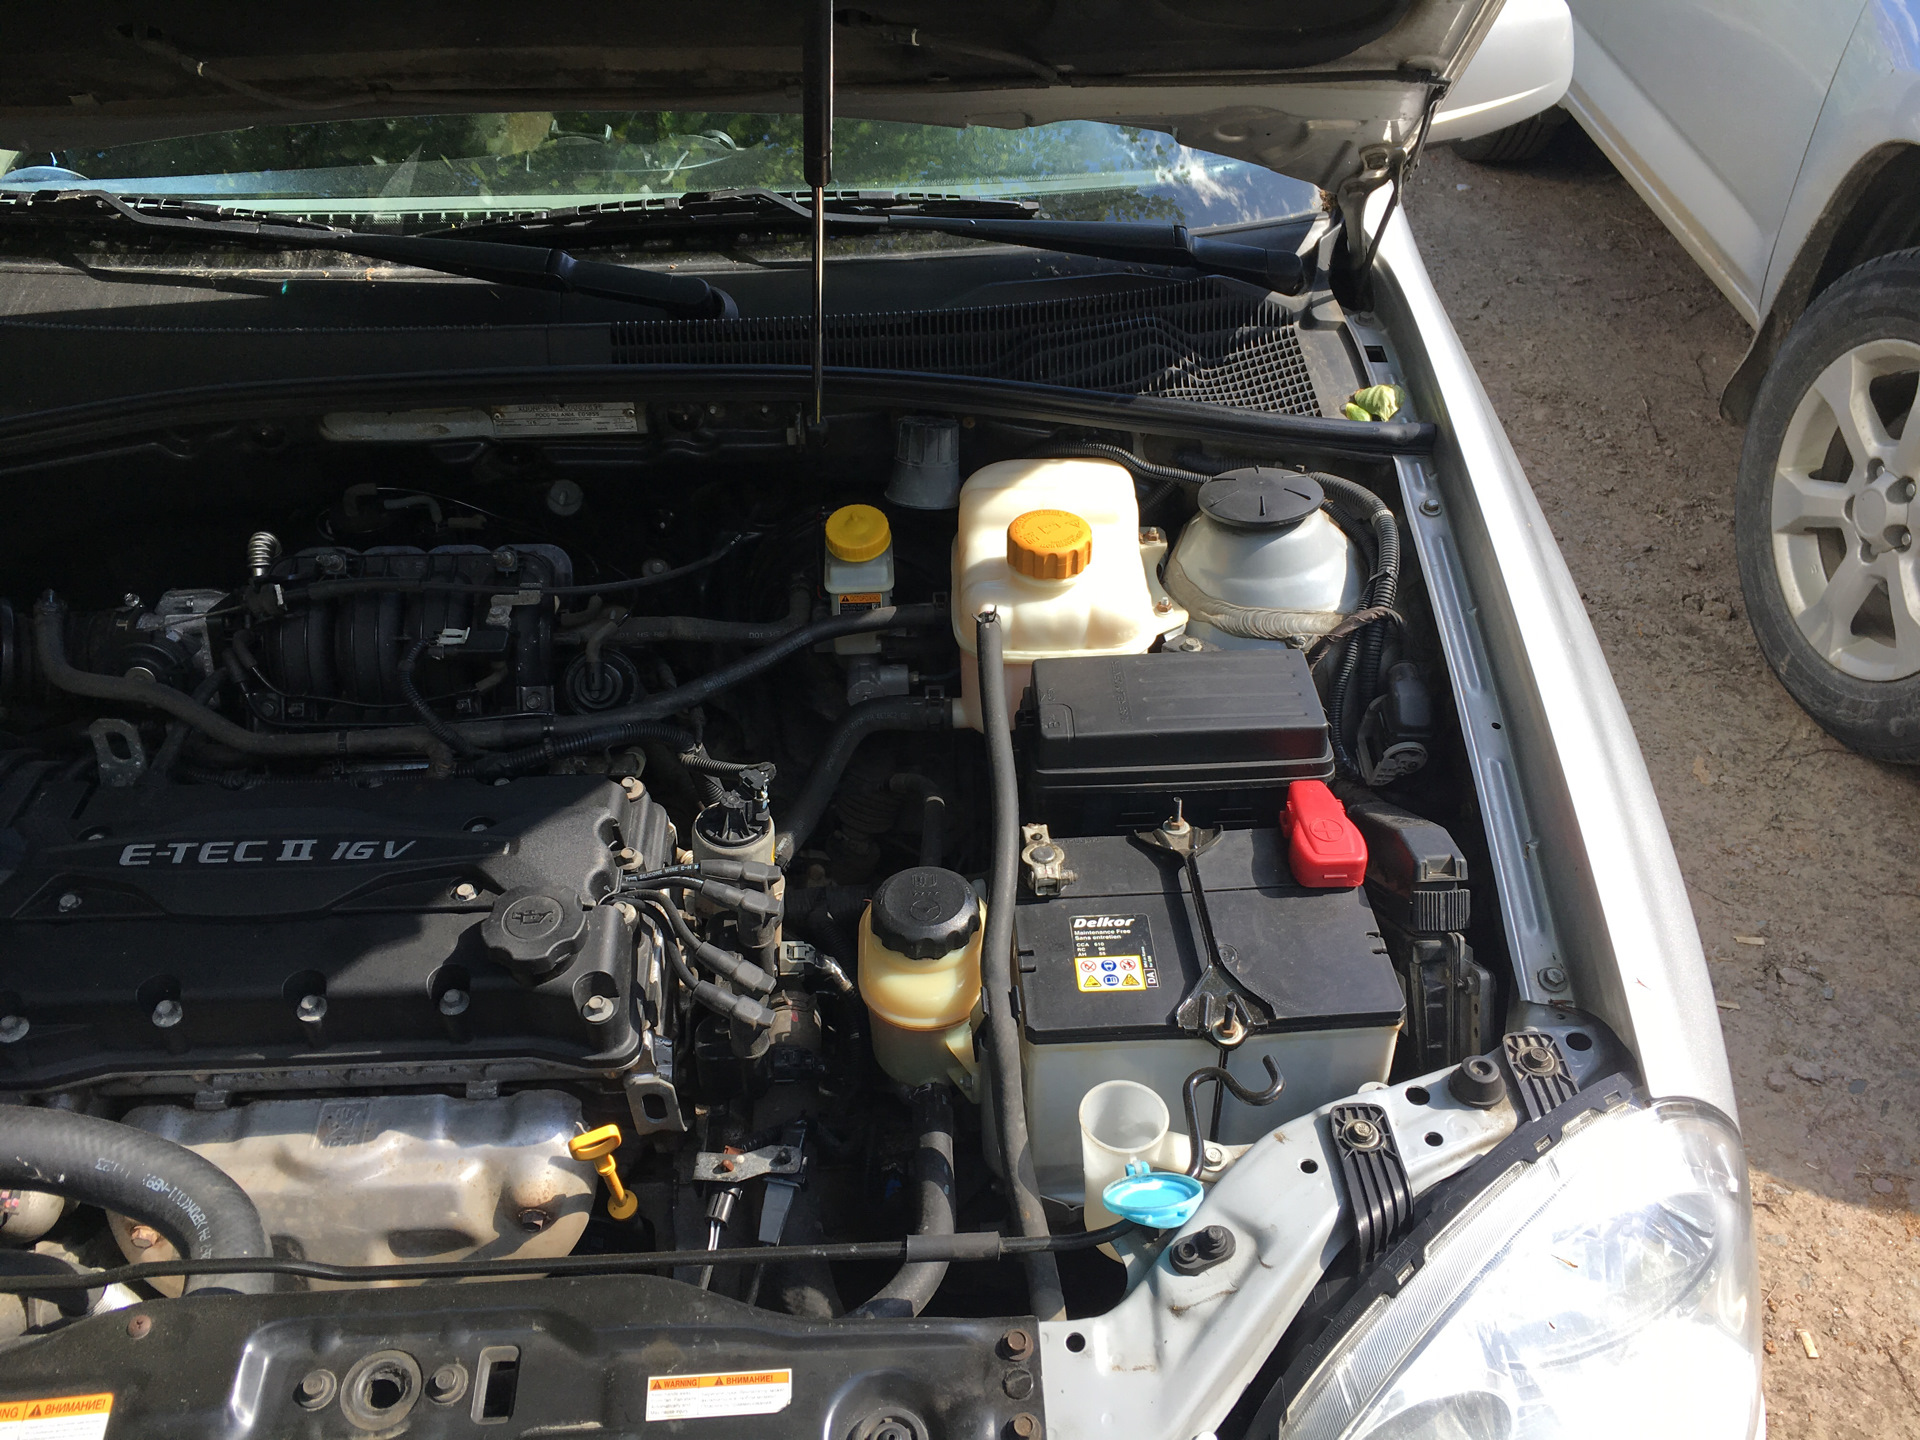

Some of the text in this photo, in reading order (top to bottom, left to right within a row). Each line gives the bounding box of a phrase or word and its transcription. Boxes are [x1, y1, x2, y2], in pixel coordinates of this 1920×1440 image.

[119, 840, 268, 866] E-TEC
[640, 870, 662, 879] SILICONE
[1074, 917, 1135, 928] Delkor
[1147, 972, 1156, 984] DA
[664, 1379, 697, 1388] WARNING
[726, 1375, 773, 1385] ВНИМАНИЕ!
[44, 1399, 106, 1415] ВНИМАНИЕ!
